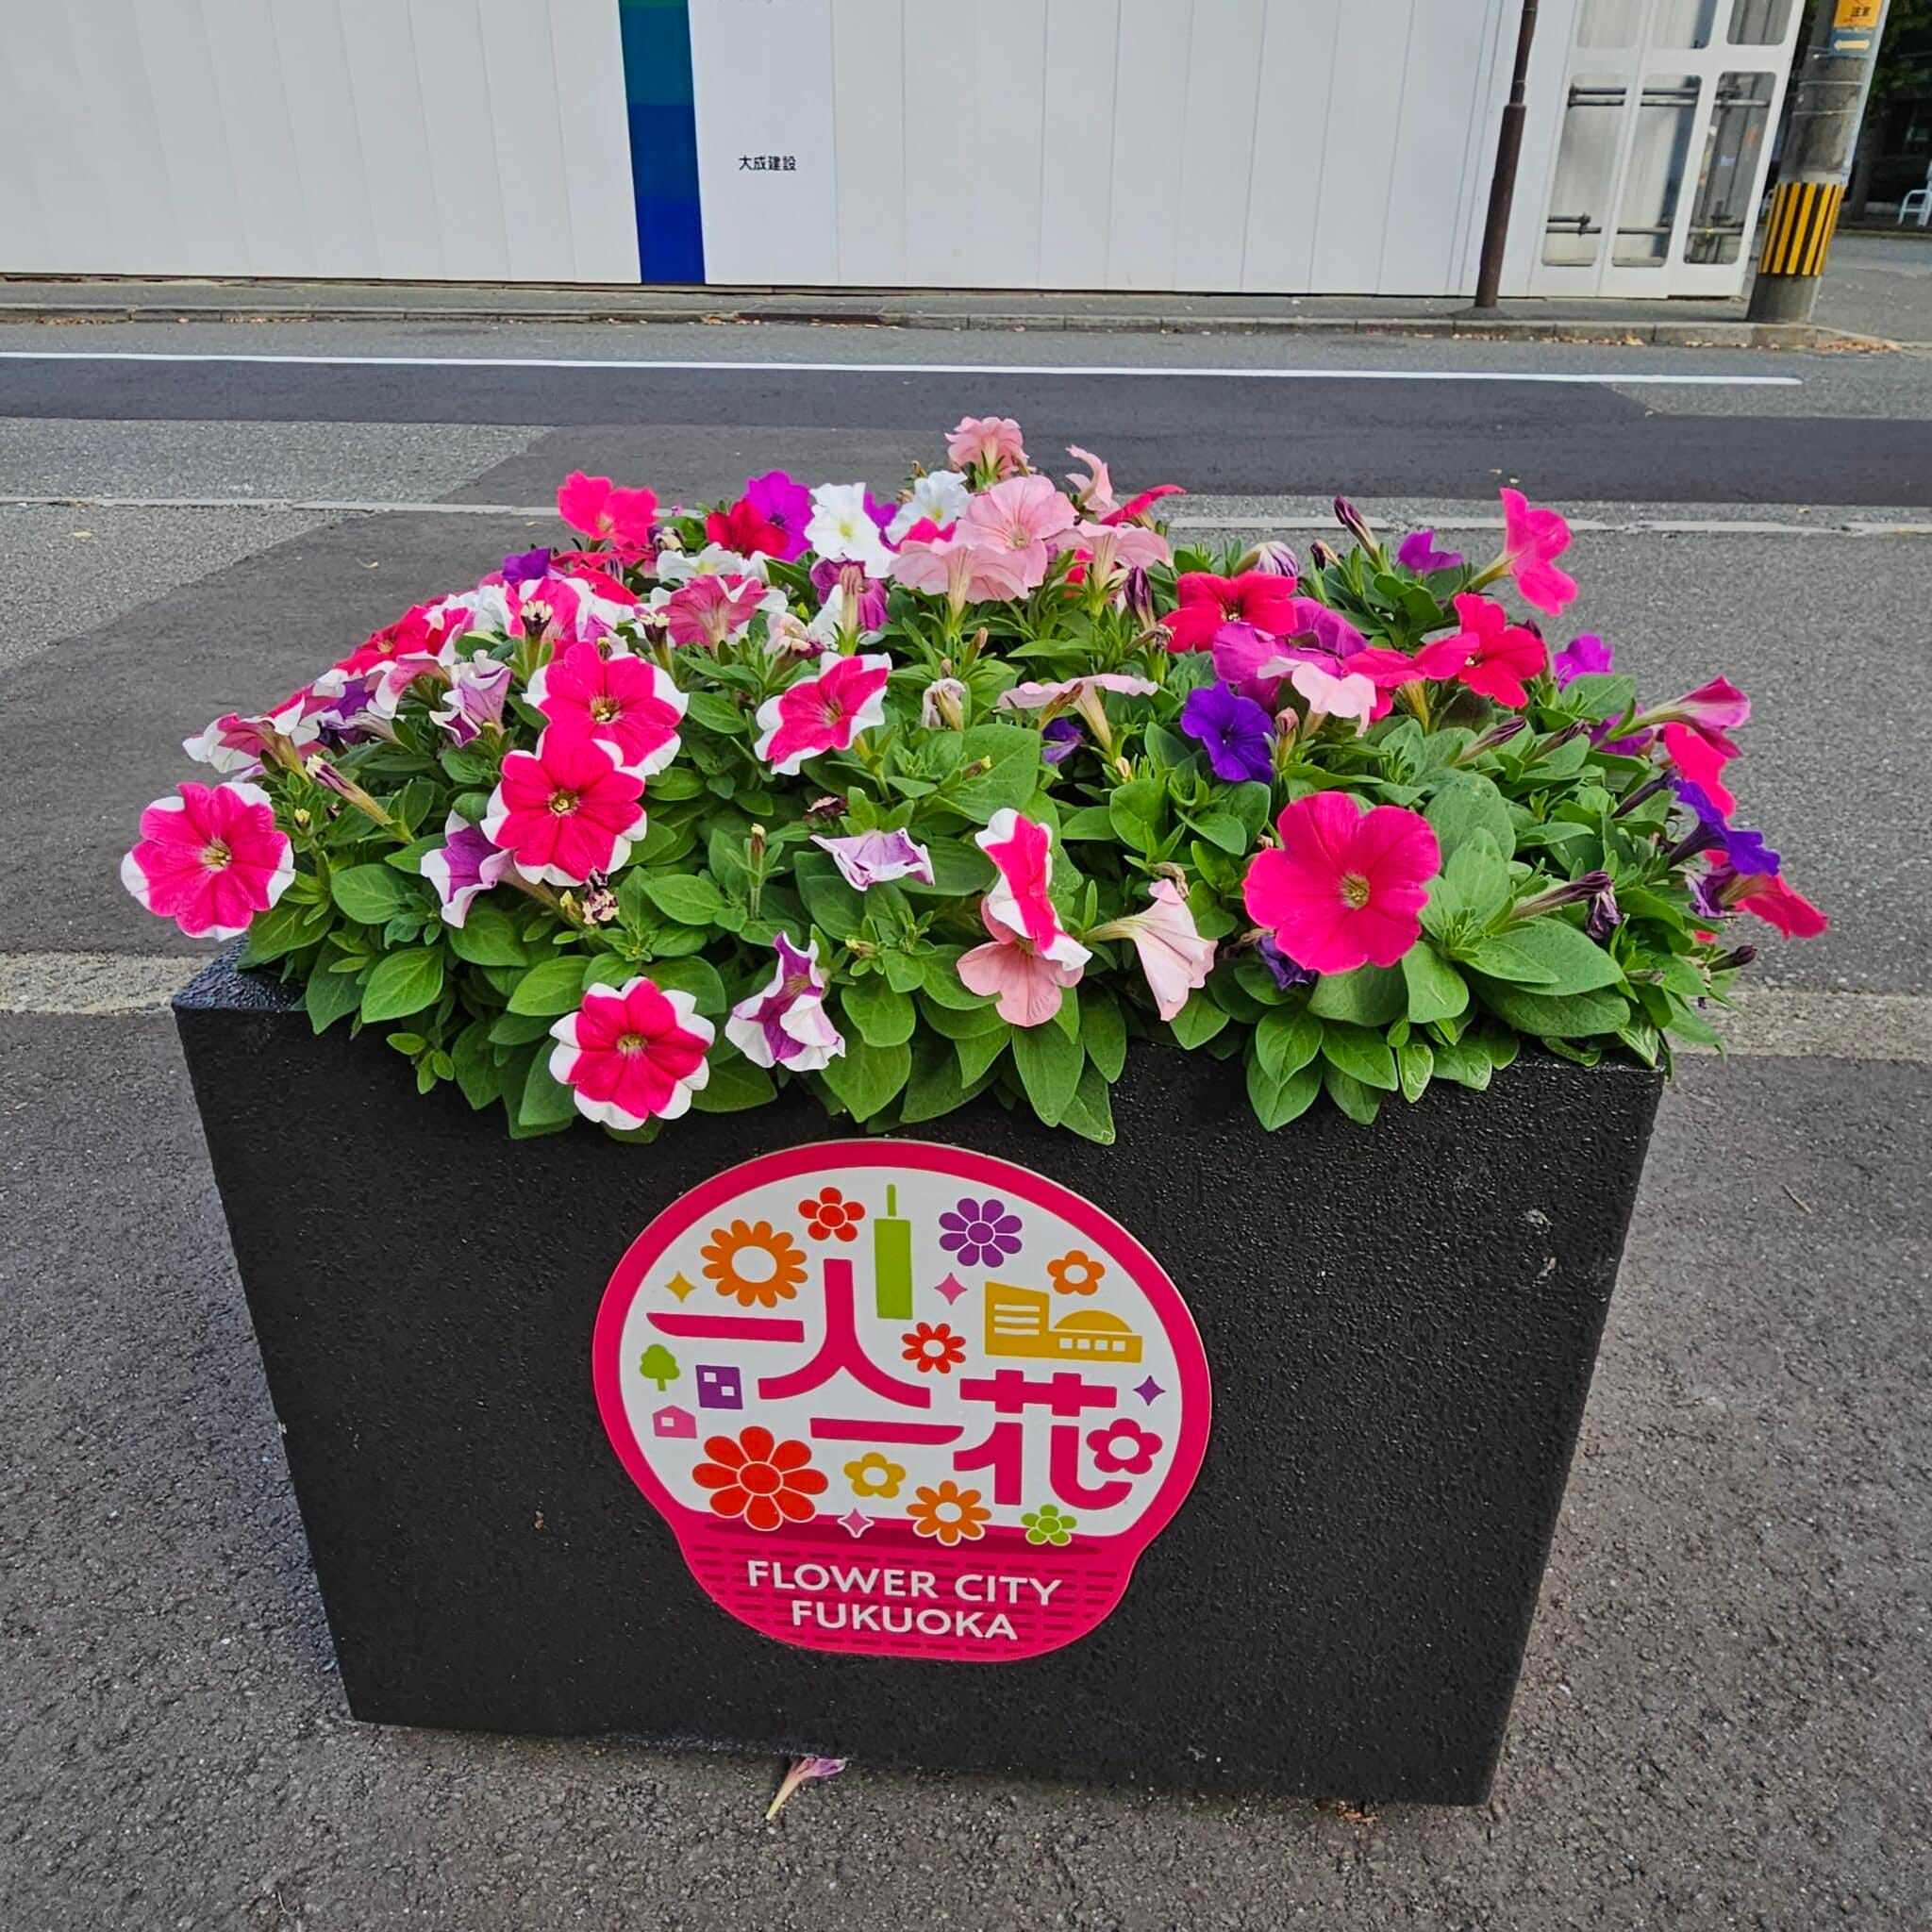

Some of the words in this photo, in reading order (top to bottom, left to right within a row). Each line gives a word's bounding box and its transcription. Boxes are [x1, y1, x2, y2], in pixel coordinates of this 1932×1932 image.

[739, 155, 797, 171] 大成建設
[746, 1559, 939, 1600] FLOWER
[954, 1573, 1063, 1607] CITY
[791, 1600, 1019, 1641] FUKUOKA
